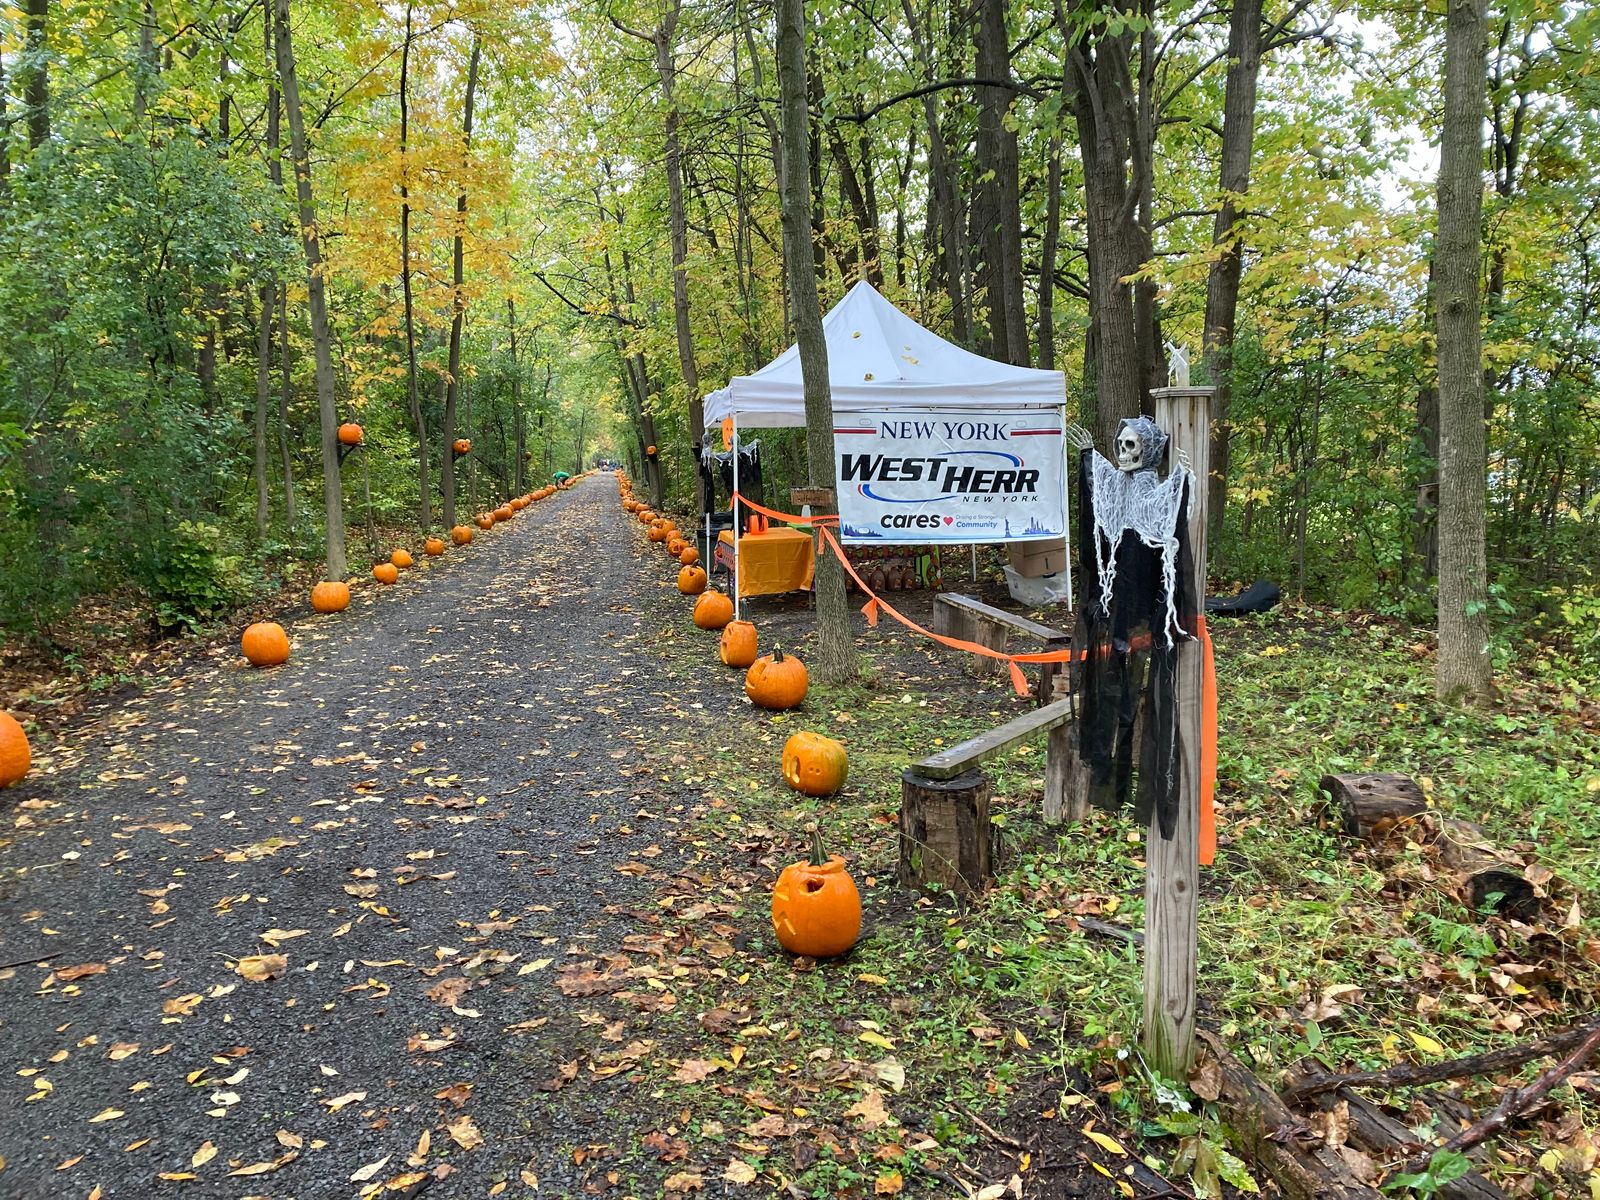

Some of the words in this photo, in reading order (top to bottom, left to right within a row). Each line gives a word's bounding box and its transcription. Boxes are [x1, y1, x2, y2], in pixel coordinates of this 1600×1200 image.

[881, 421, 936, 439] NEW
[943, 422, 1009, 440] YORK
[841, 454, 948, 481] WEST
[941, 466, 1039, 493] HERR
[962, 495, 993, 503] NEW
[1002, 494, 1038, 503] YORK
[881, 513, 940, 529] cares
[956, 520, 998, 529] Community
